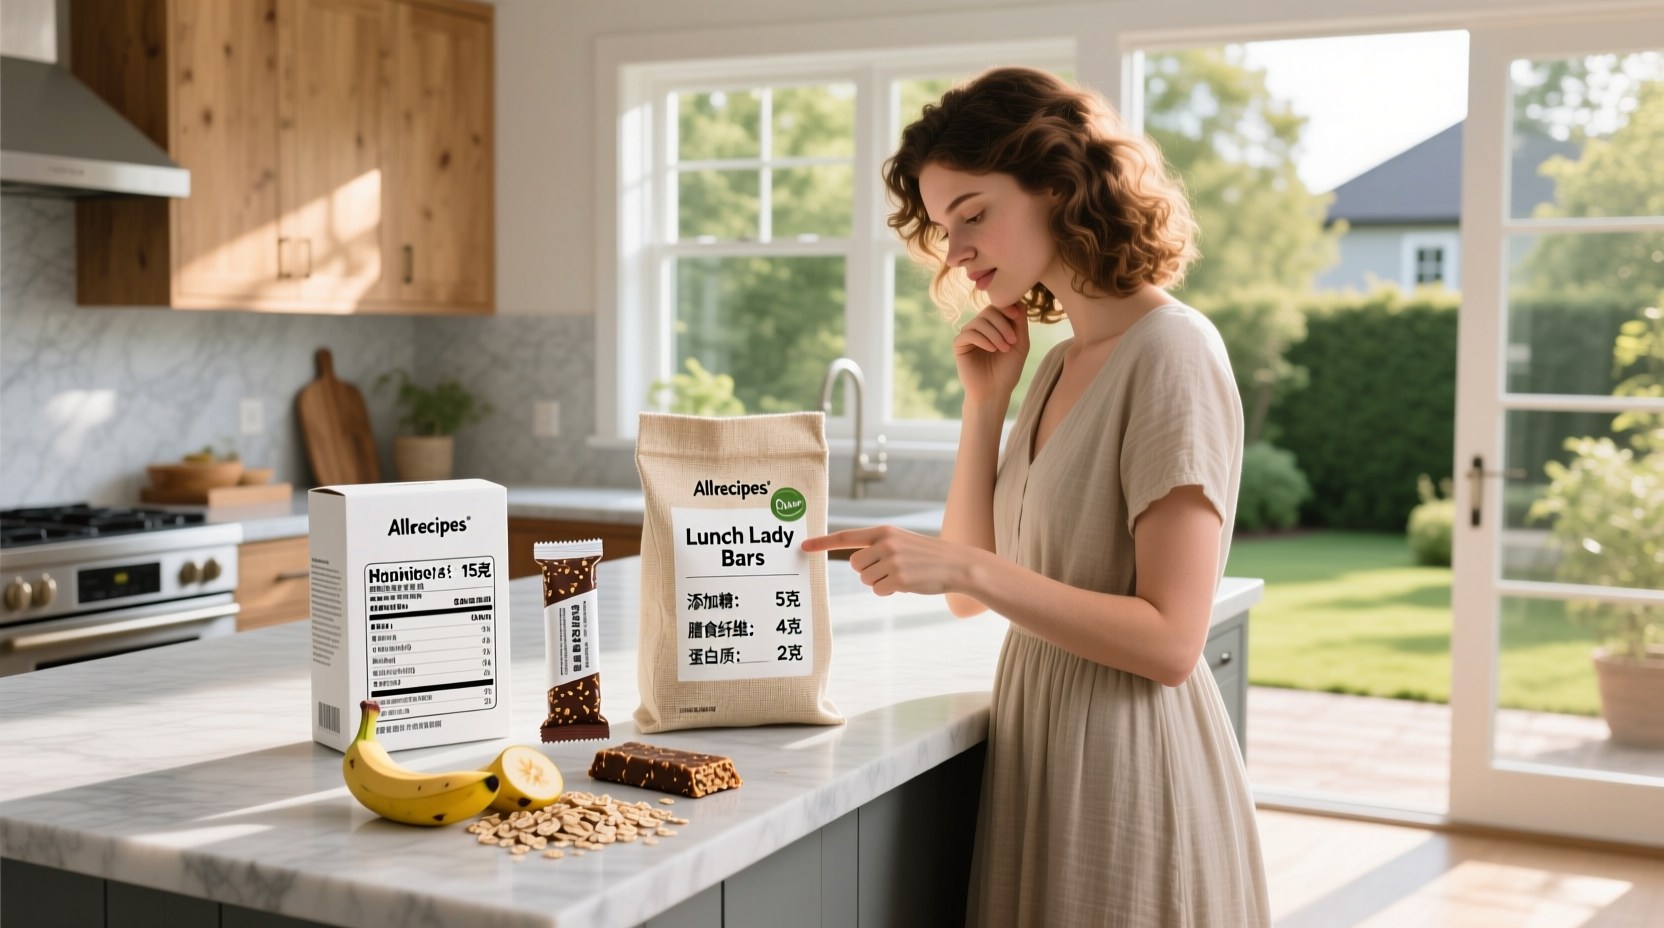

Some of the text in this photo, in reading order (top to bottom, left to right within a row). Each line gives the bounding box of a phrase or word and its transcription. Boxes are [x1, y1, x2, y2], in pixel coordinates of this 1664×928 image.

[686, 525, 794, 548] Lunch Lady
[721, 549, 765, 567] Bars
[461, 561, 492, 579] 15克
[775, 590, 801, 608] 5克
[776, 617, 802, 635] 4克
[777, 644, 803, 661] 2克
